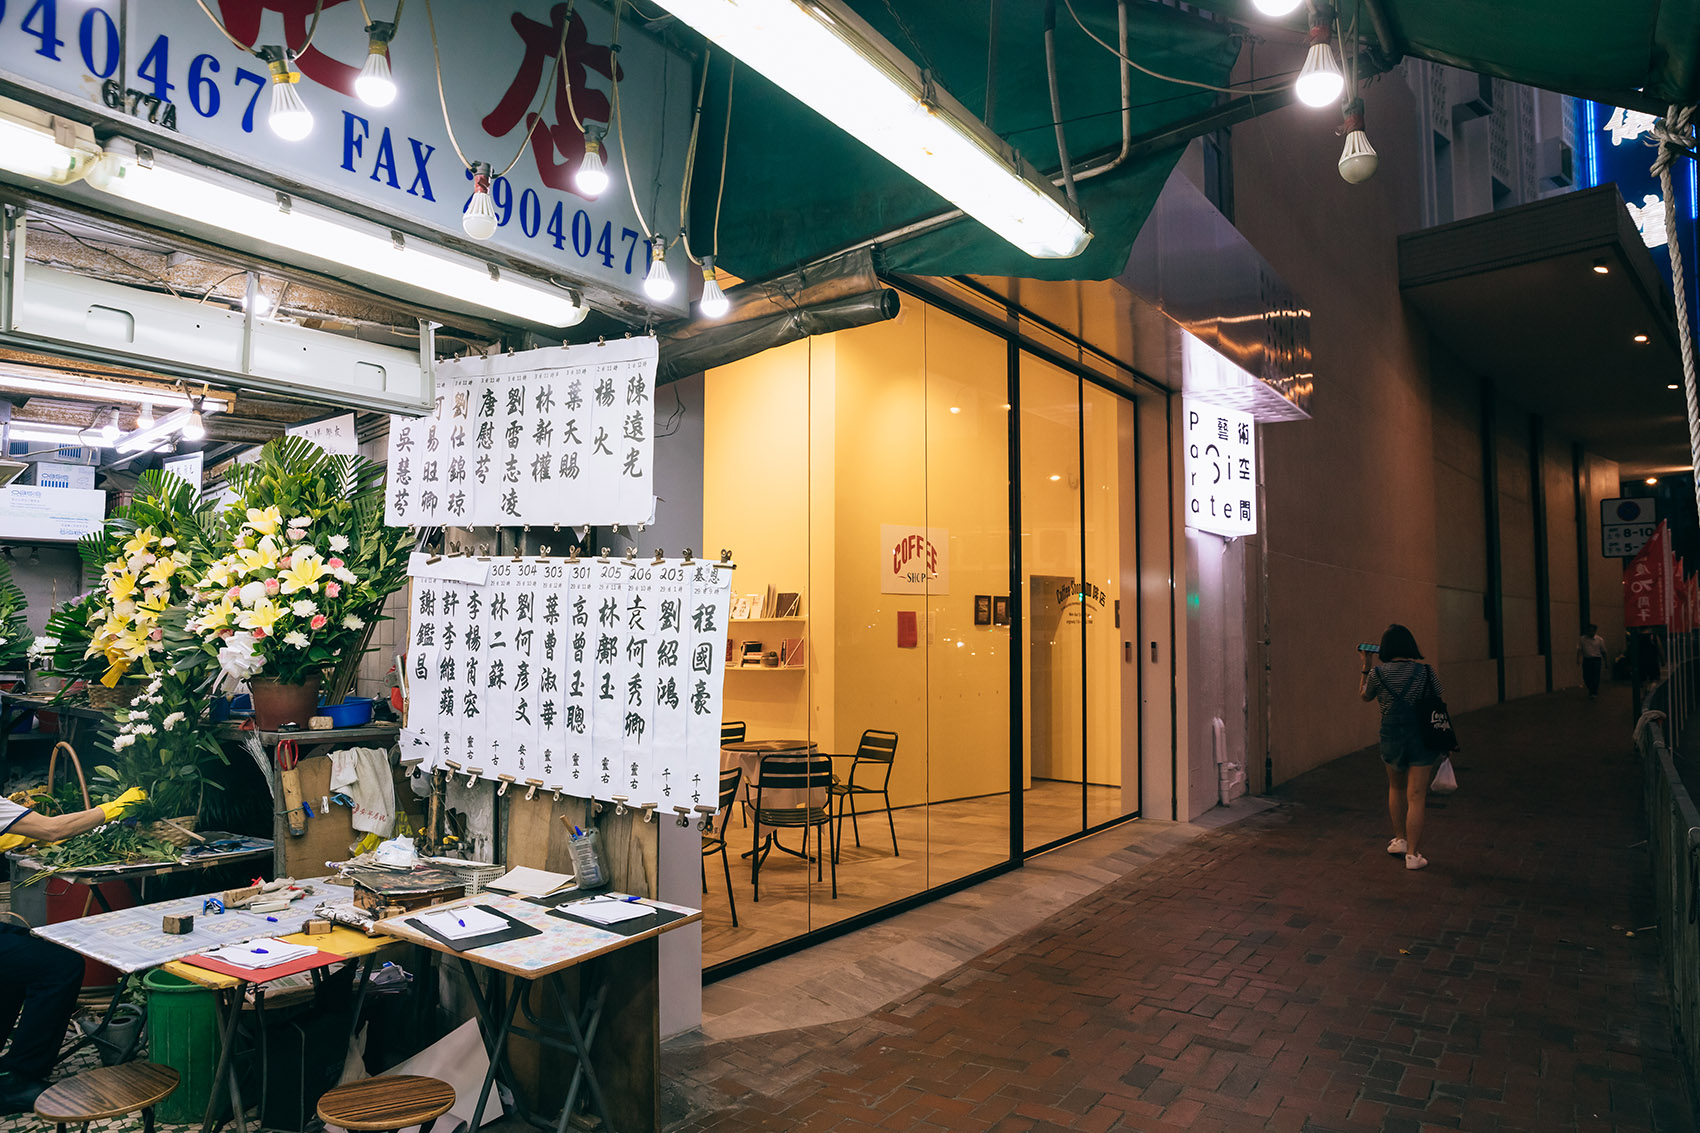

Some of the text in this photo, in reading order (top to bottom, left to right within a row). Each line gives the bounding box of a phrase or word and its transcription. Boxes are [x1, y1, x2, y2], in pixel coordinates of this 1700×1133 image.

[0, 0, 266, 133] 40467
[102, 78, 179, 132] 677A
[340, 110, 436, 203] FAX
[530, 384, 556, 483] 林新權
[559, 379, 583, 480] 葉天賜
[623, 373, 649, 478] 陳遠光
[394, 415, 418, 517] 吳慧芬
[893, 534, 938, 578] COFFEE
[1623, 527, 1653, 538] 8-10
[491, 564, 511, 577] 305
[518, 564, 538, 577] 304
[544, 565, 563, 579] 303
[572, 566, 591, 579] 301
[600, 566, 622, 579] 205
[629, 567, 652, 581] 206
[659, 567, 684, 582] 203
[487, 592, 509, 766] 林二蘇 千古
[540, 592, 560, 731] 葉曹淑華
[657, 597, 681, 797] 劉紹鴻 千古
[691, 603, 717, 803] 程國豪 千古
